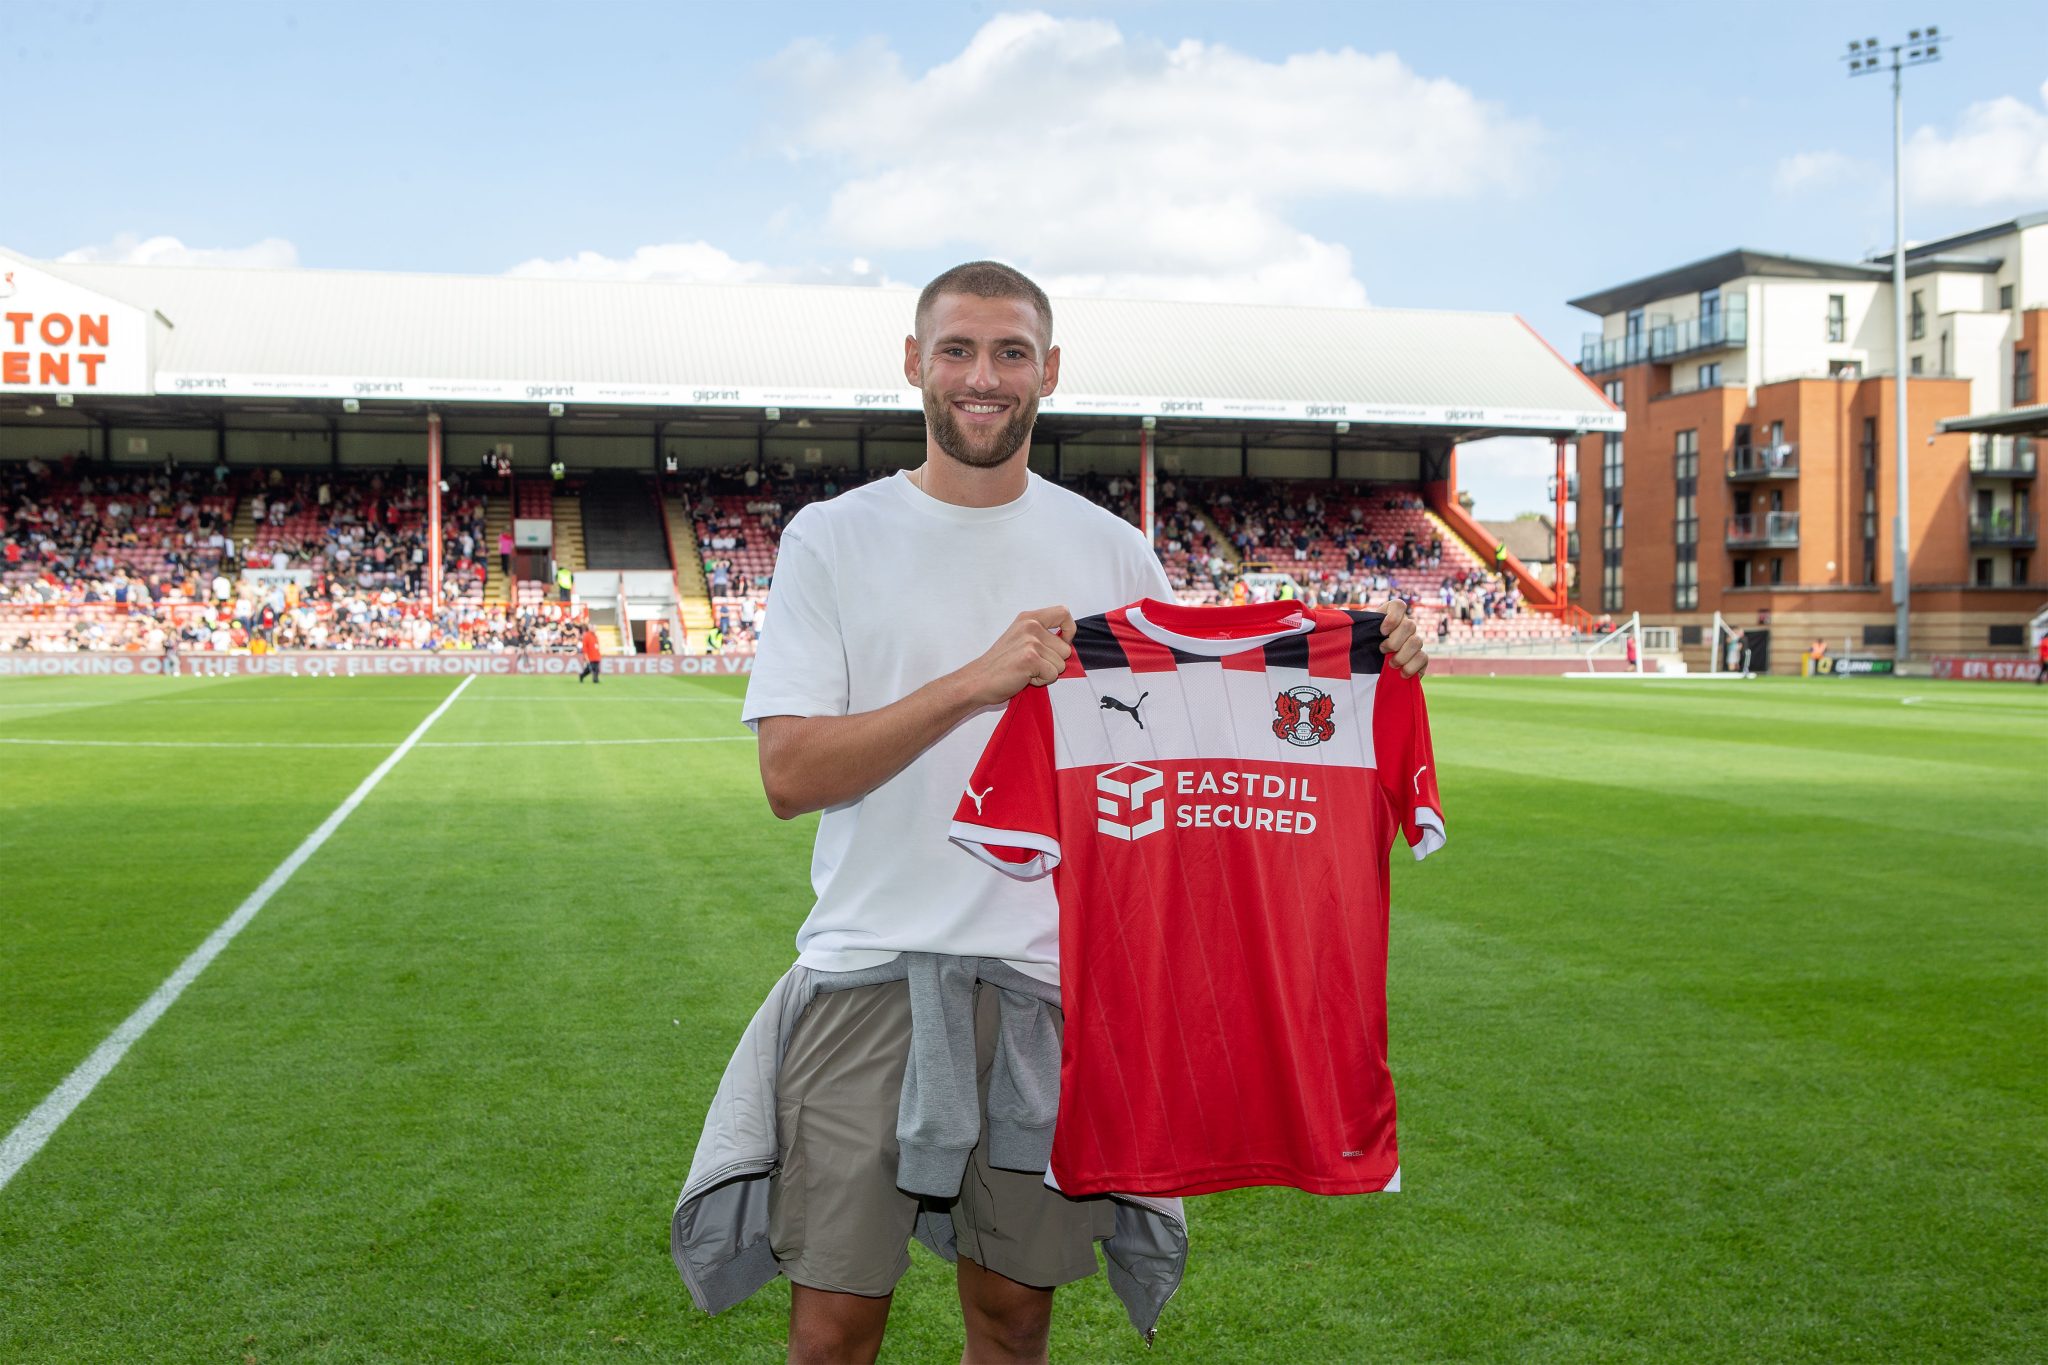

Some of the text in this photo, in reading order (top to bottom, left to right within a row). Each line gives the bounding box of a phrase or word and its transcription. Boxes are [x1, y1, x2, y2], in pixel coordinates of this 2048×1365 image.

[6, 312, 109, 347] TON
[3, 351, 106, 386] ENT
[353, 381, 403, 393] giprint
[526, 385, 574, 397] giprint
[693, 388, 740, 401] giprint
[854, 391, 900, 404] giprint
[1161, 400, 1203, 412] giprint
[1305, 403, 1347, 416] giprint
[1445, 408, 1484, 421] giprint
[0, 656, 134, 674] SMOKING
[187, 656, 238, 674] THE
[245, 656, 297, 674] USE
[303, 656, 340, 674] OF
[346, 656, 511, 674] ELECTRONIC
[517, 656, 675, 674] CIGAETTES
[681, 657, 717, 673] OR
[1177, 771, 1318, 802] EASTDIL
[1176, 804, 1317, 835] SECURED
